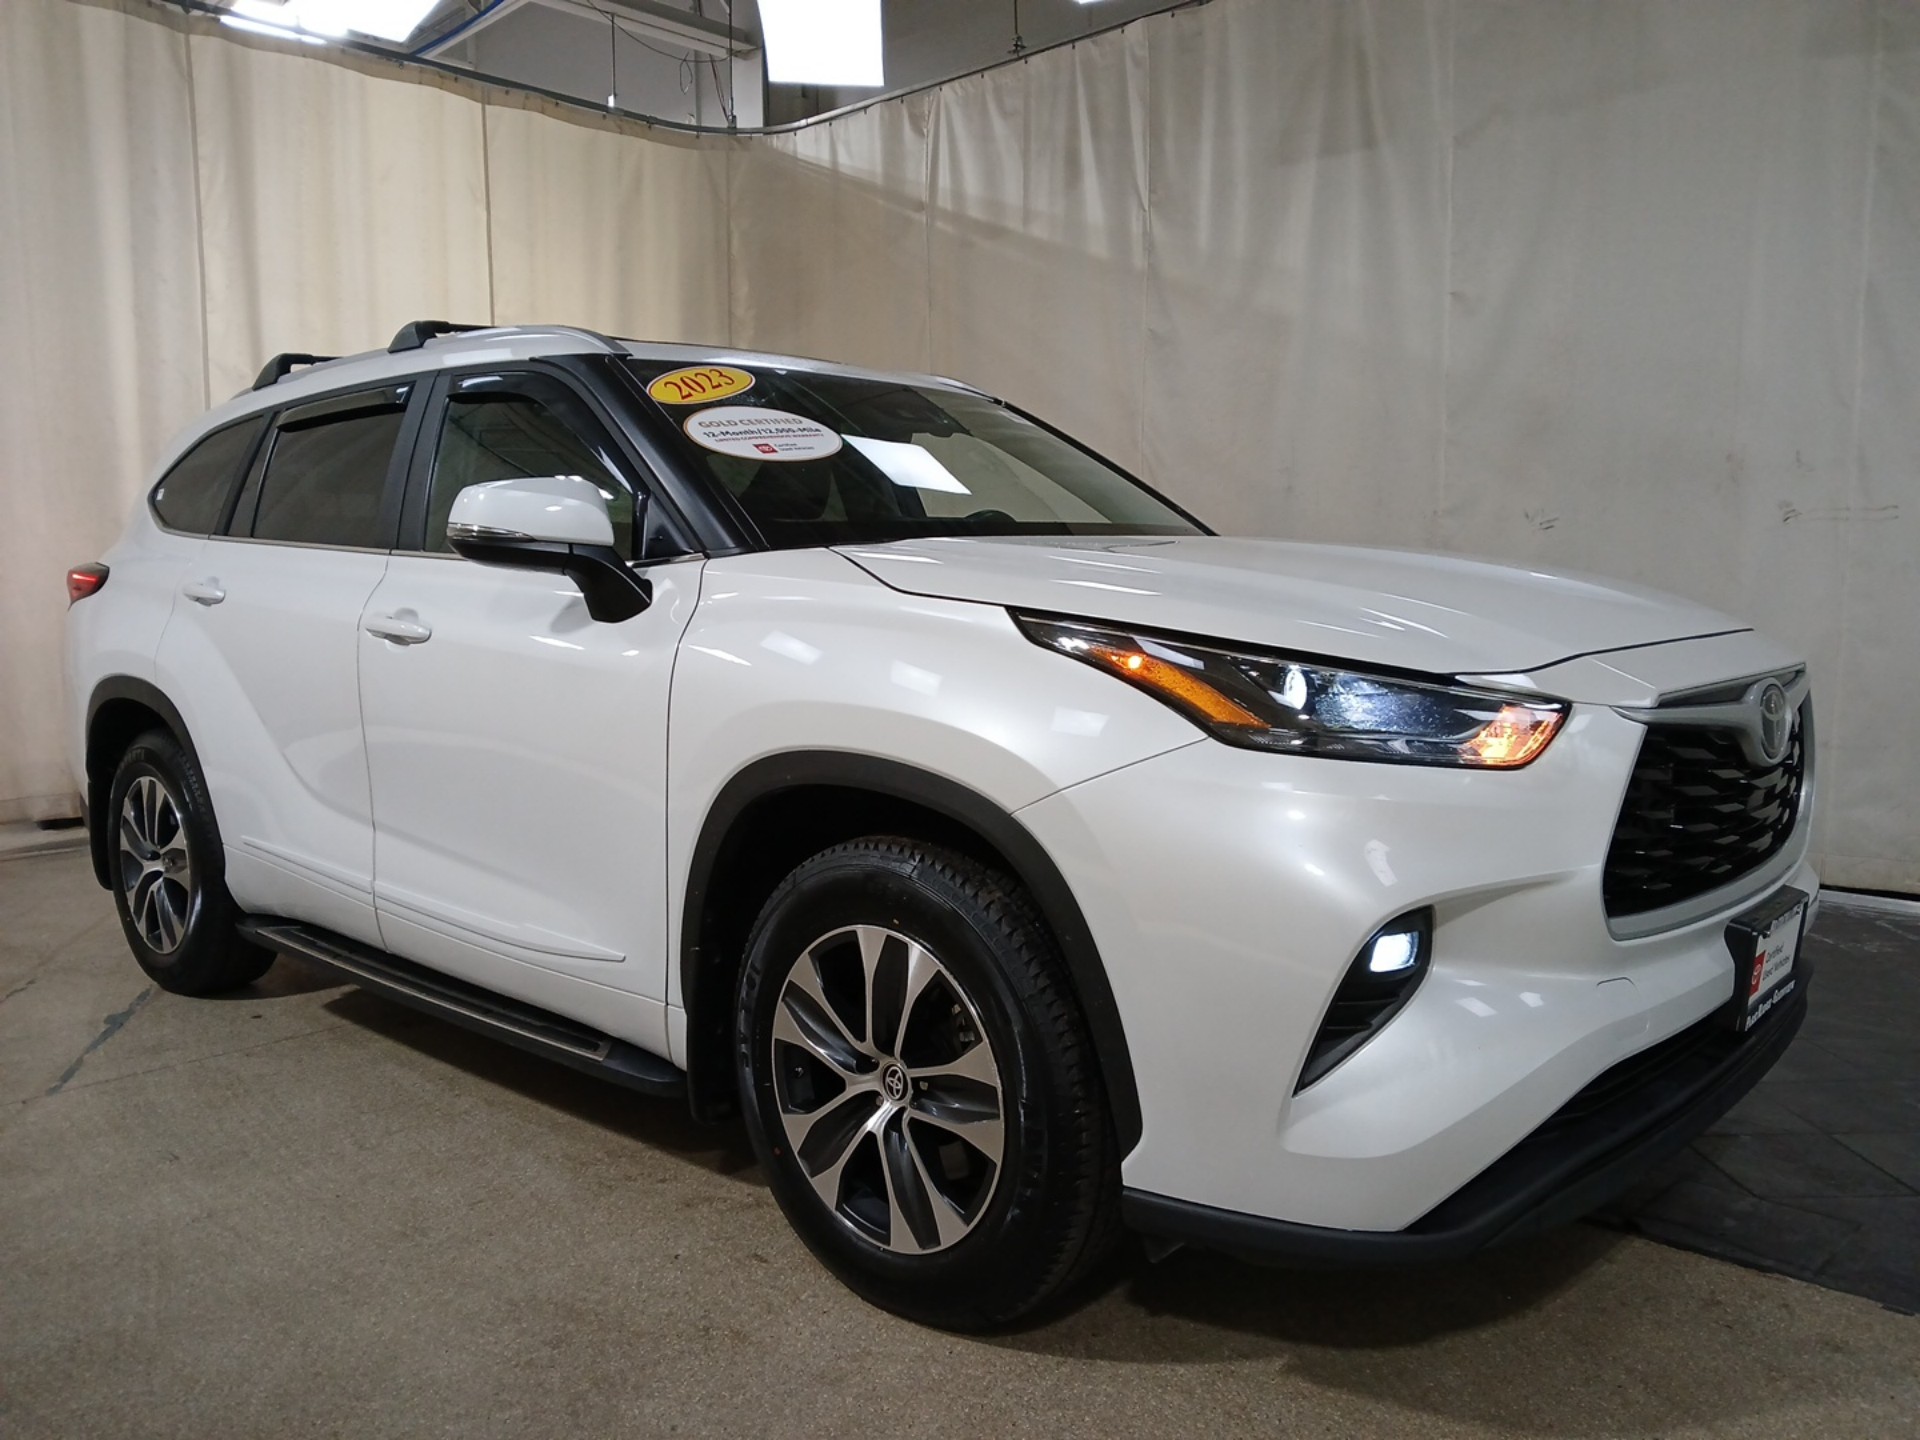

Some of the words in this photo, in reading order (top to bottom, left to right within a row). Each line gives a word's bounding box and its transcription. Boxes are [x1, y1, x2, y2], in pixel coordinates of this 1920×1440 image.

[664, 368, 735, 400] 2023
[698, 419, 738, 428] GOLD
[738, 417, 803, 426] CERTIFIED
